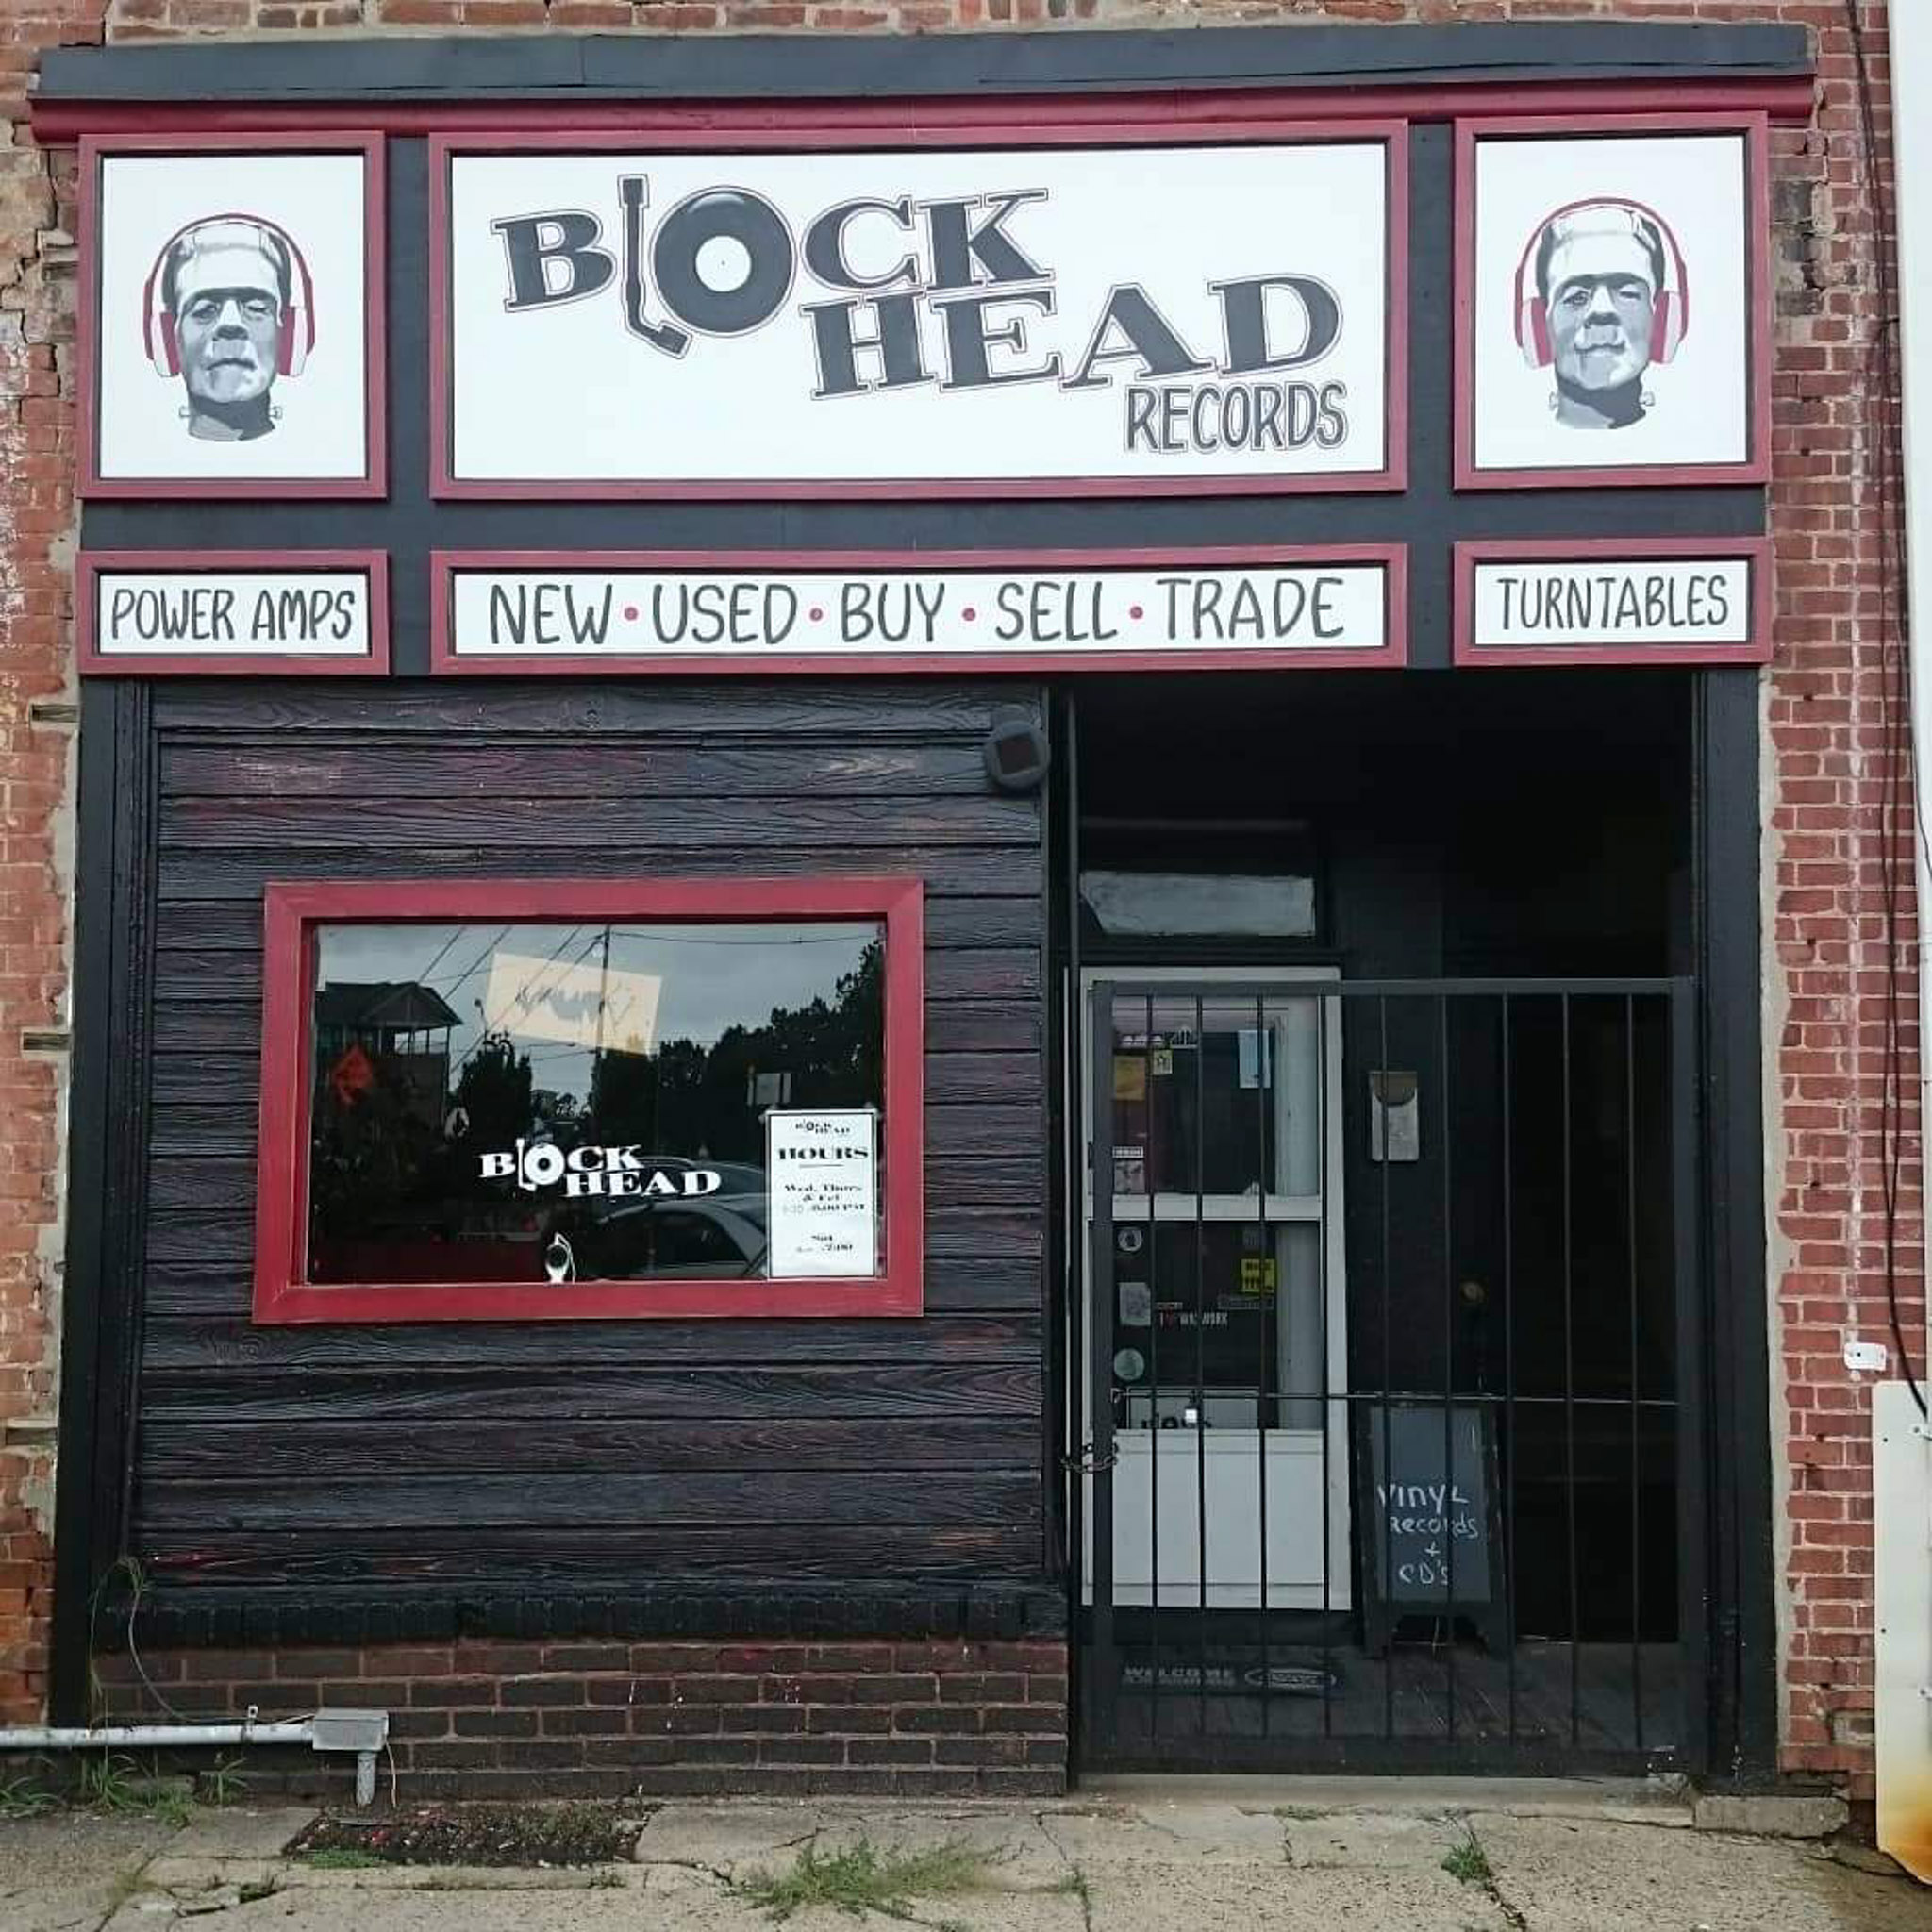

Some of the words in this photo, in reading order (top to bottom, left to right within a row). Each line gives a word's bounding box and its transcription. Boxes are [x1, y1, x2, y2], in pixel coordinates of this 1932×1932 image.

[490, 173, 1055, 359] BLOCK
[799, 273, 1344, 400] HEAD
[1125, 380, 1349, 454] RECORDS
[111, 588, 235, 641] POWER
[251, 588, 356, 641] AMPS
[489, 583, 613, 645] NEW
[652, 583, 798, 644] USED
[841, 581, 945, 643] BUY
[995, 580, 1118, 642] SELL
[1155, 576, 1344, 640] TRADE
[1496, 574, 1729, 630] TURNTABLES
[476, 1137, 646, 1192] BLOCK
[778, 1147, 869, 1160] HOURS
[560, 1169, 723, 1198] HEAD
